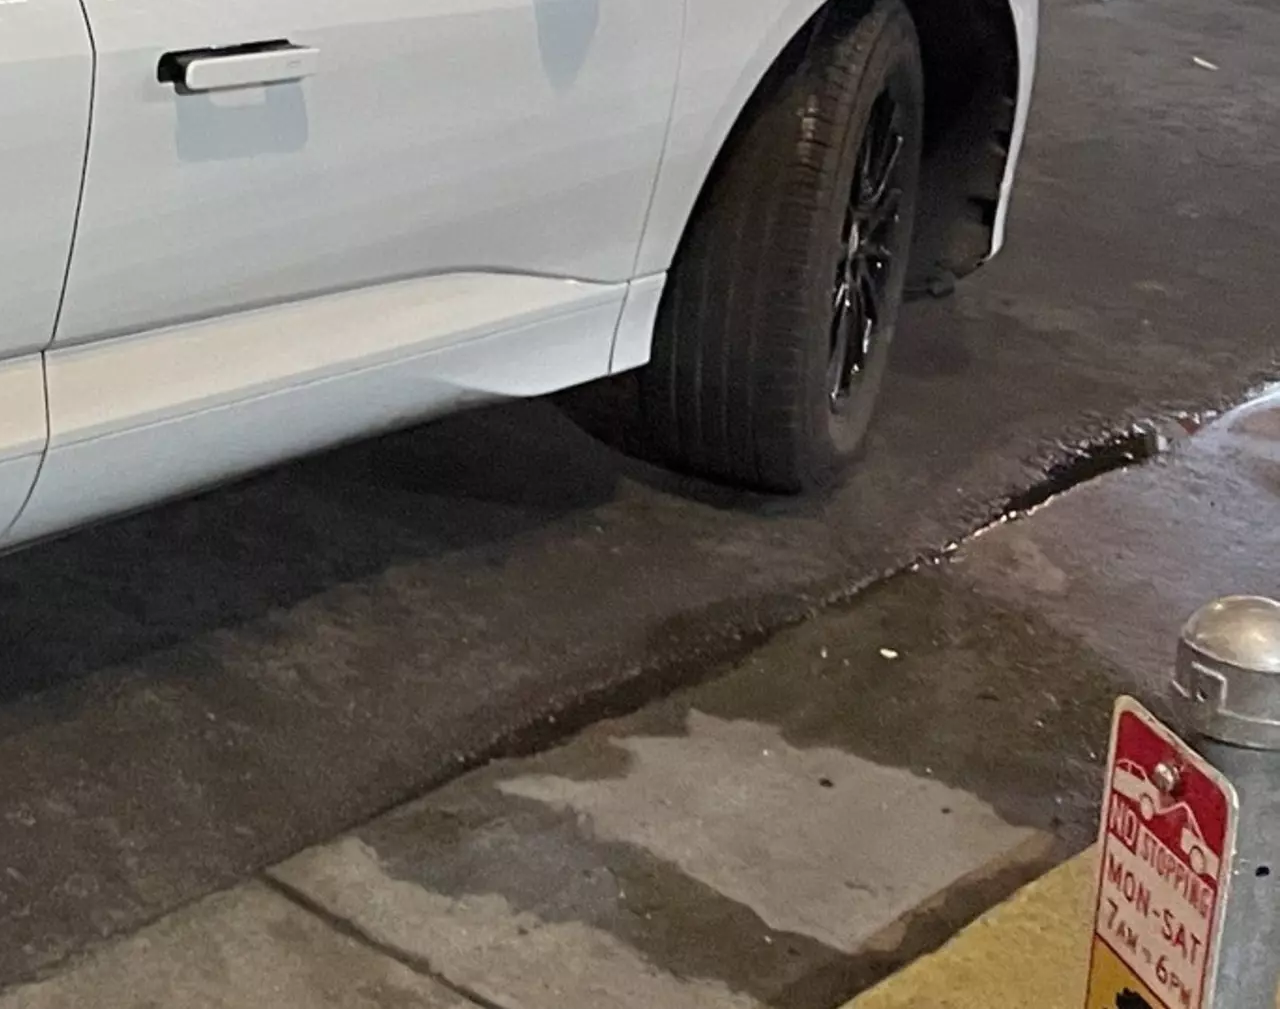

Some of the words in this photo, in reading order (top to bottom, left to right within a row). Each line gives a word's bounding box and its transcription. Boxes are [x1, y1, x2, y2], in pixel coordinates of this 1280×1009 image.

[1107, 852, 1202, 965] MON-SAT
[1109, 792, 1138, 847] NO
[1141, 832, 1210, 919] STOPPING
[1155, 954, 1192, 1007] 6PM
